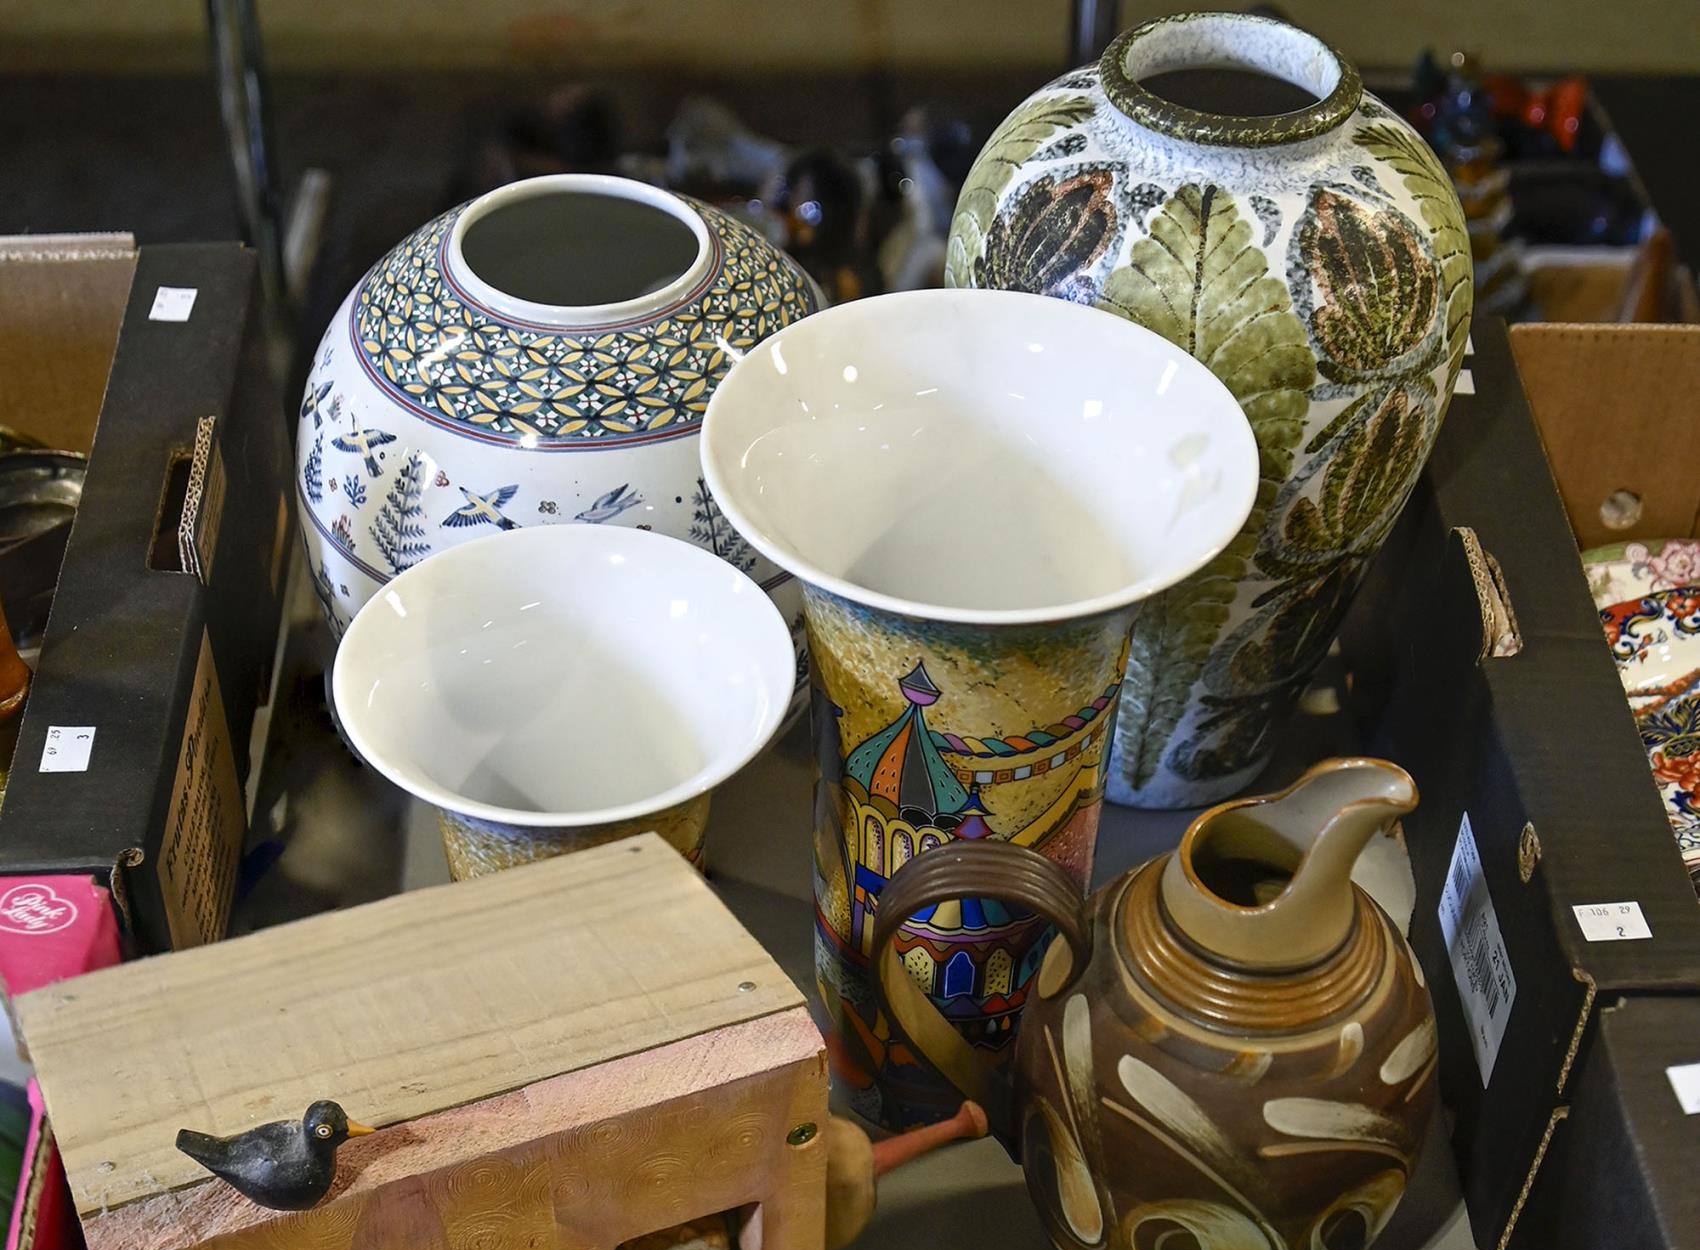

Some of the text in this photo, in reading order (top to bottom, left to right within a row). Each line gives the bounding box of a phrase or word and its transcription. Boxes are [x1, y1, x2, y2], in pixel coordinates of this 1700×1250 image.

[50, 729, 61, 739] 25
[11, 892, 67, 920] Pink
[1590, 907, 1609, 917] 106
[1618, 905, 1631, 915] 29
[1, 905, 49, 929] Lady
[1616, 926, 1626, 938] 2
[1491, 950, 1510, 1005] 21 JAN
